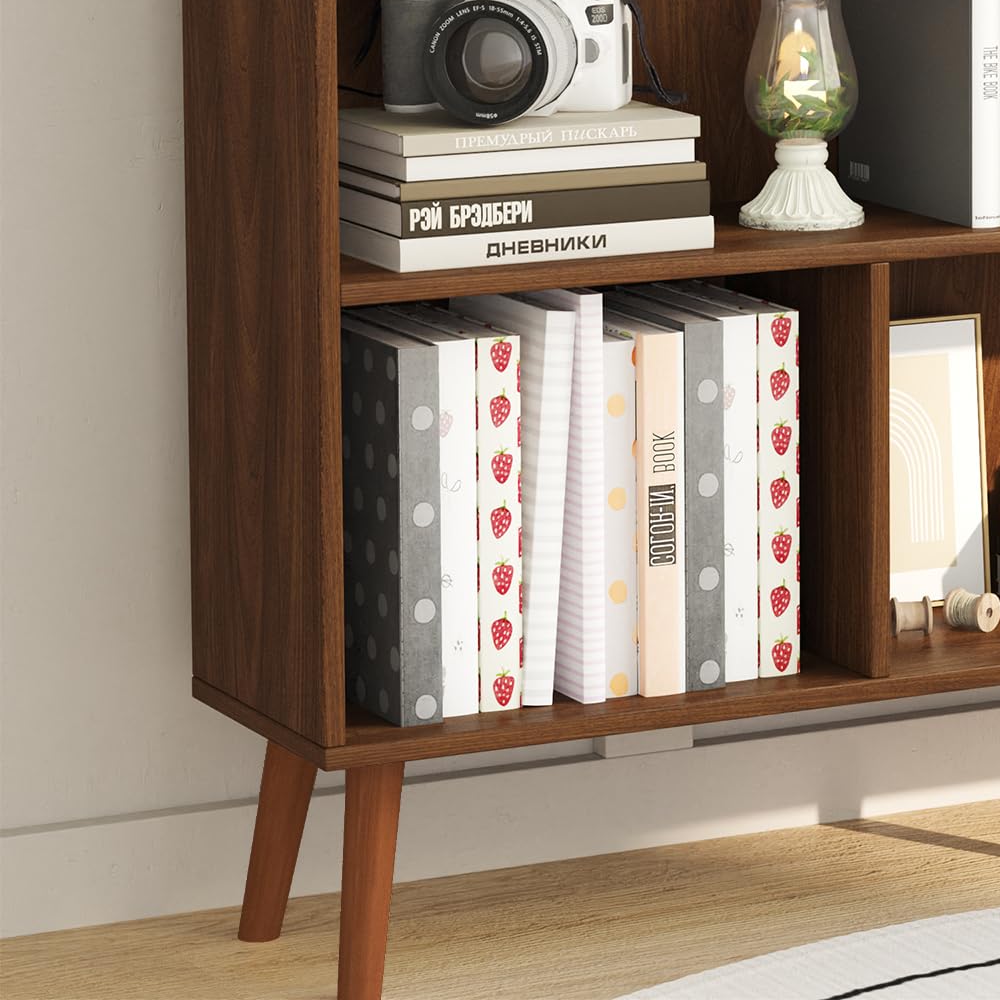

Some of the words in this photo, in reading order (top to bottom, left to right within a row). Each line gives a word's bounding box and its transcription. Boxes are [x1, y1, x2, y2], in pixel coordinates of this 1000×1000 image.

[429, 31, 441, 54] CANON
[439, 15, 455, 32] ZOOM
[455, 7, 471, 18] LENS
[488, 5, 514, 18] 18-55mm
[515, 16, 532, 34] 1:4-5.6
[530, 33, 537, 41] IS
[534, 42, 543, 56] STM
[983, 46, 998, 60] THE
[983, 62, 998, 79] BIKE
[983, 81, 998, 101] BOOK
[409, 202, 443, 232] РЭЙ
[450, 200, 533, 229] БРЭДБЕРИ
[486, 234, 607, 259] ДНЕВНИКИ
